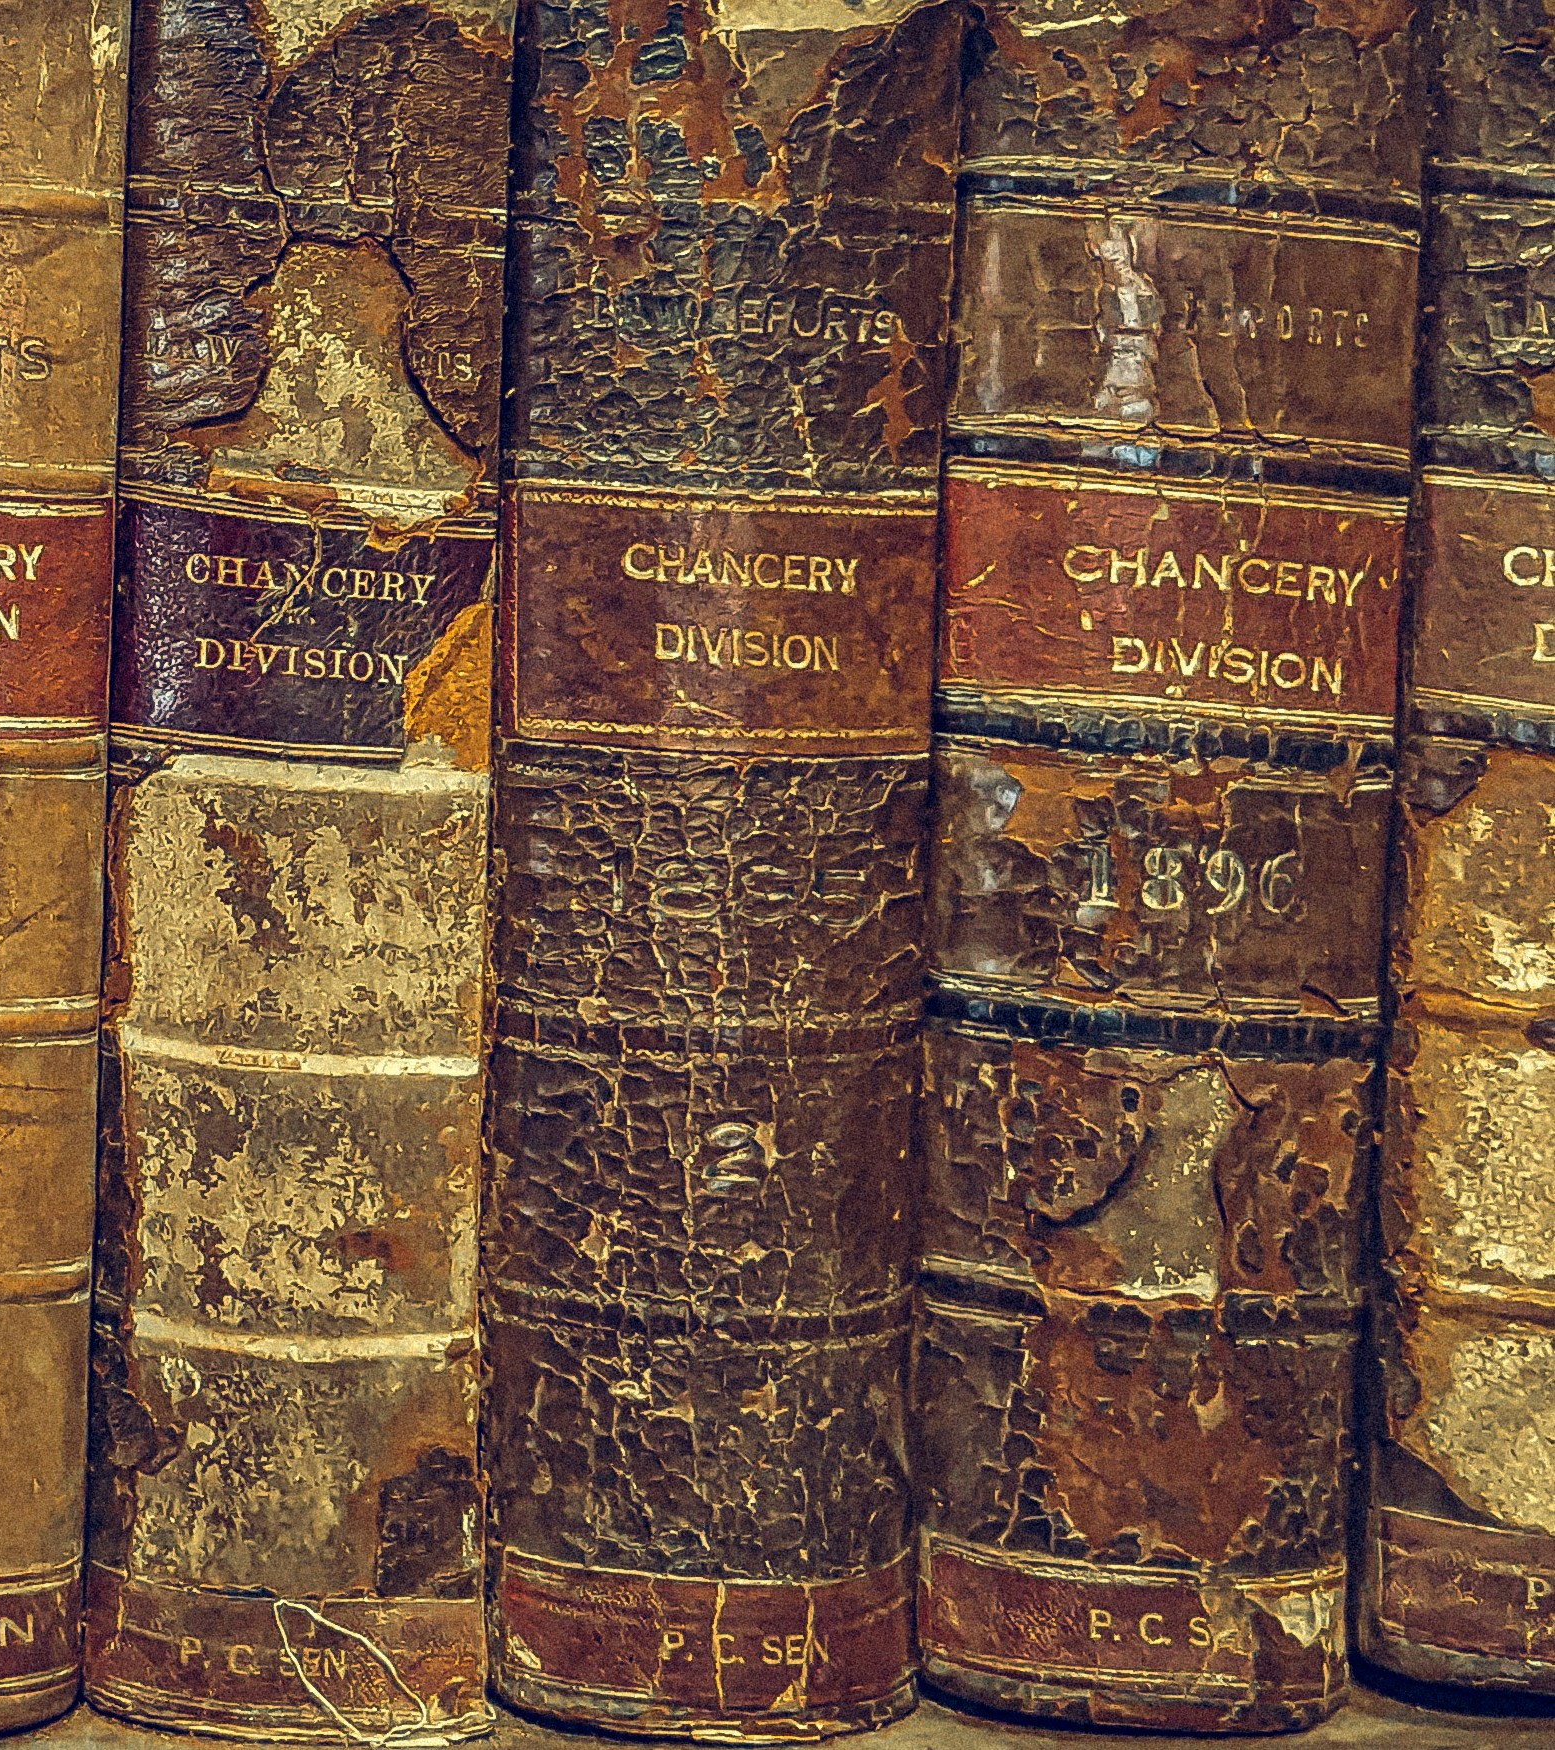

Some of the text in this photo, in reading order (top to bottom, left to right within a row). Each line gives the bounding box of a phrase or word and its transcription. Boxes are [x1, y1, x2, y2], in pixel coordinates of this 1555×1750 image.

[185, 552, 436, 606] CHANCERY
[621, 542, 860, 595] CHANCERY
[1063, 543, 1366, 608] CHANCERY
[195, 637, 410, 686] DIVISION
[654, 622, 840, 672] DIVISION
[1111, 635, 1343, 695] DIVISION
[1078, 843, 1299, 916] 1896
[762, 1633, 829, 1666] SEN
